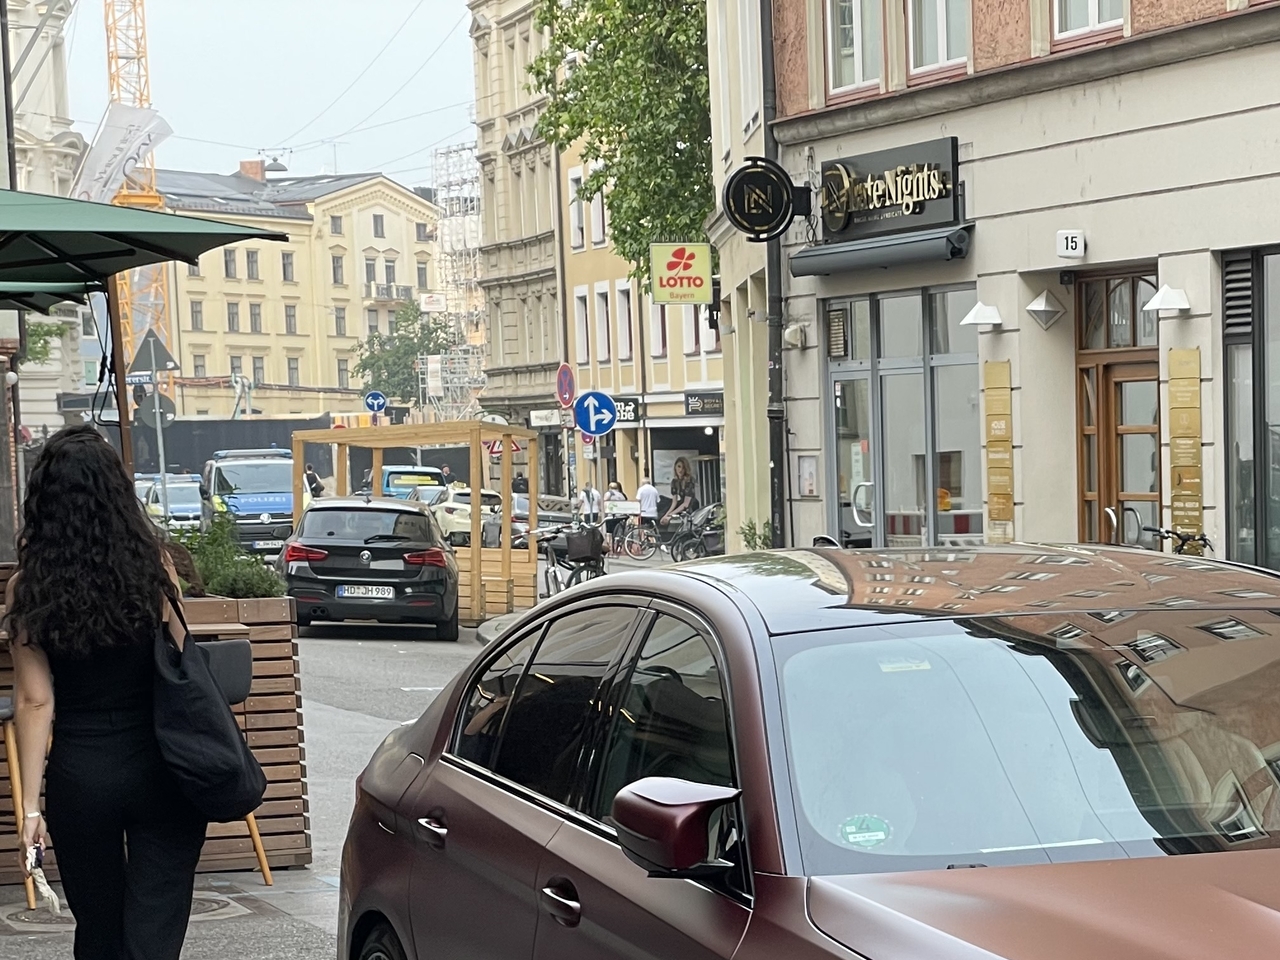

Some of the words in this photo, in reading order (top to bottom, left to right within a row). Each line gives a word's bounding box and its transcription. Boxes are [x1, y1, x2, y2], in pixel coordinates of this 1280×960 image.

[1064, 235, 1078, 251] 15
[658, 275, 704, 288] LOTTO
[669, 291, 695, 301] Bayern
[343, 586, 356, 595] HD
[361, 586, 374, 595] JH
[375, 587, 392, 596] 989
